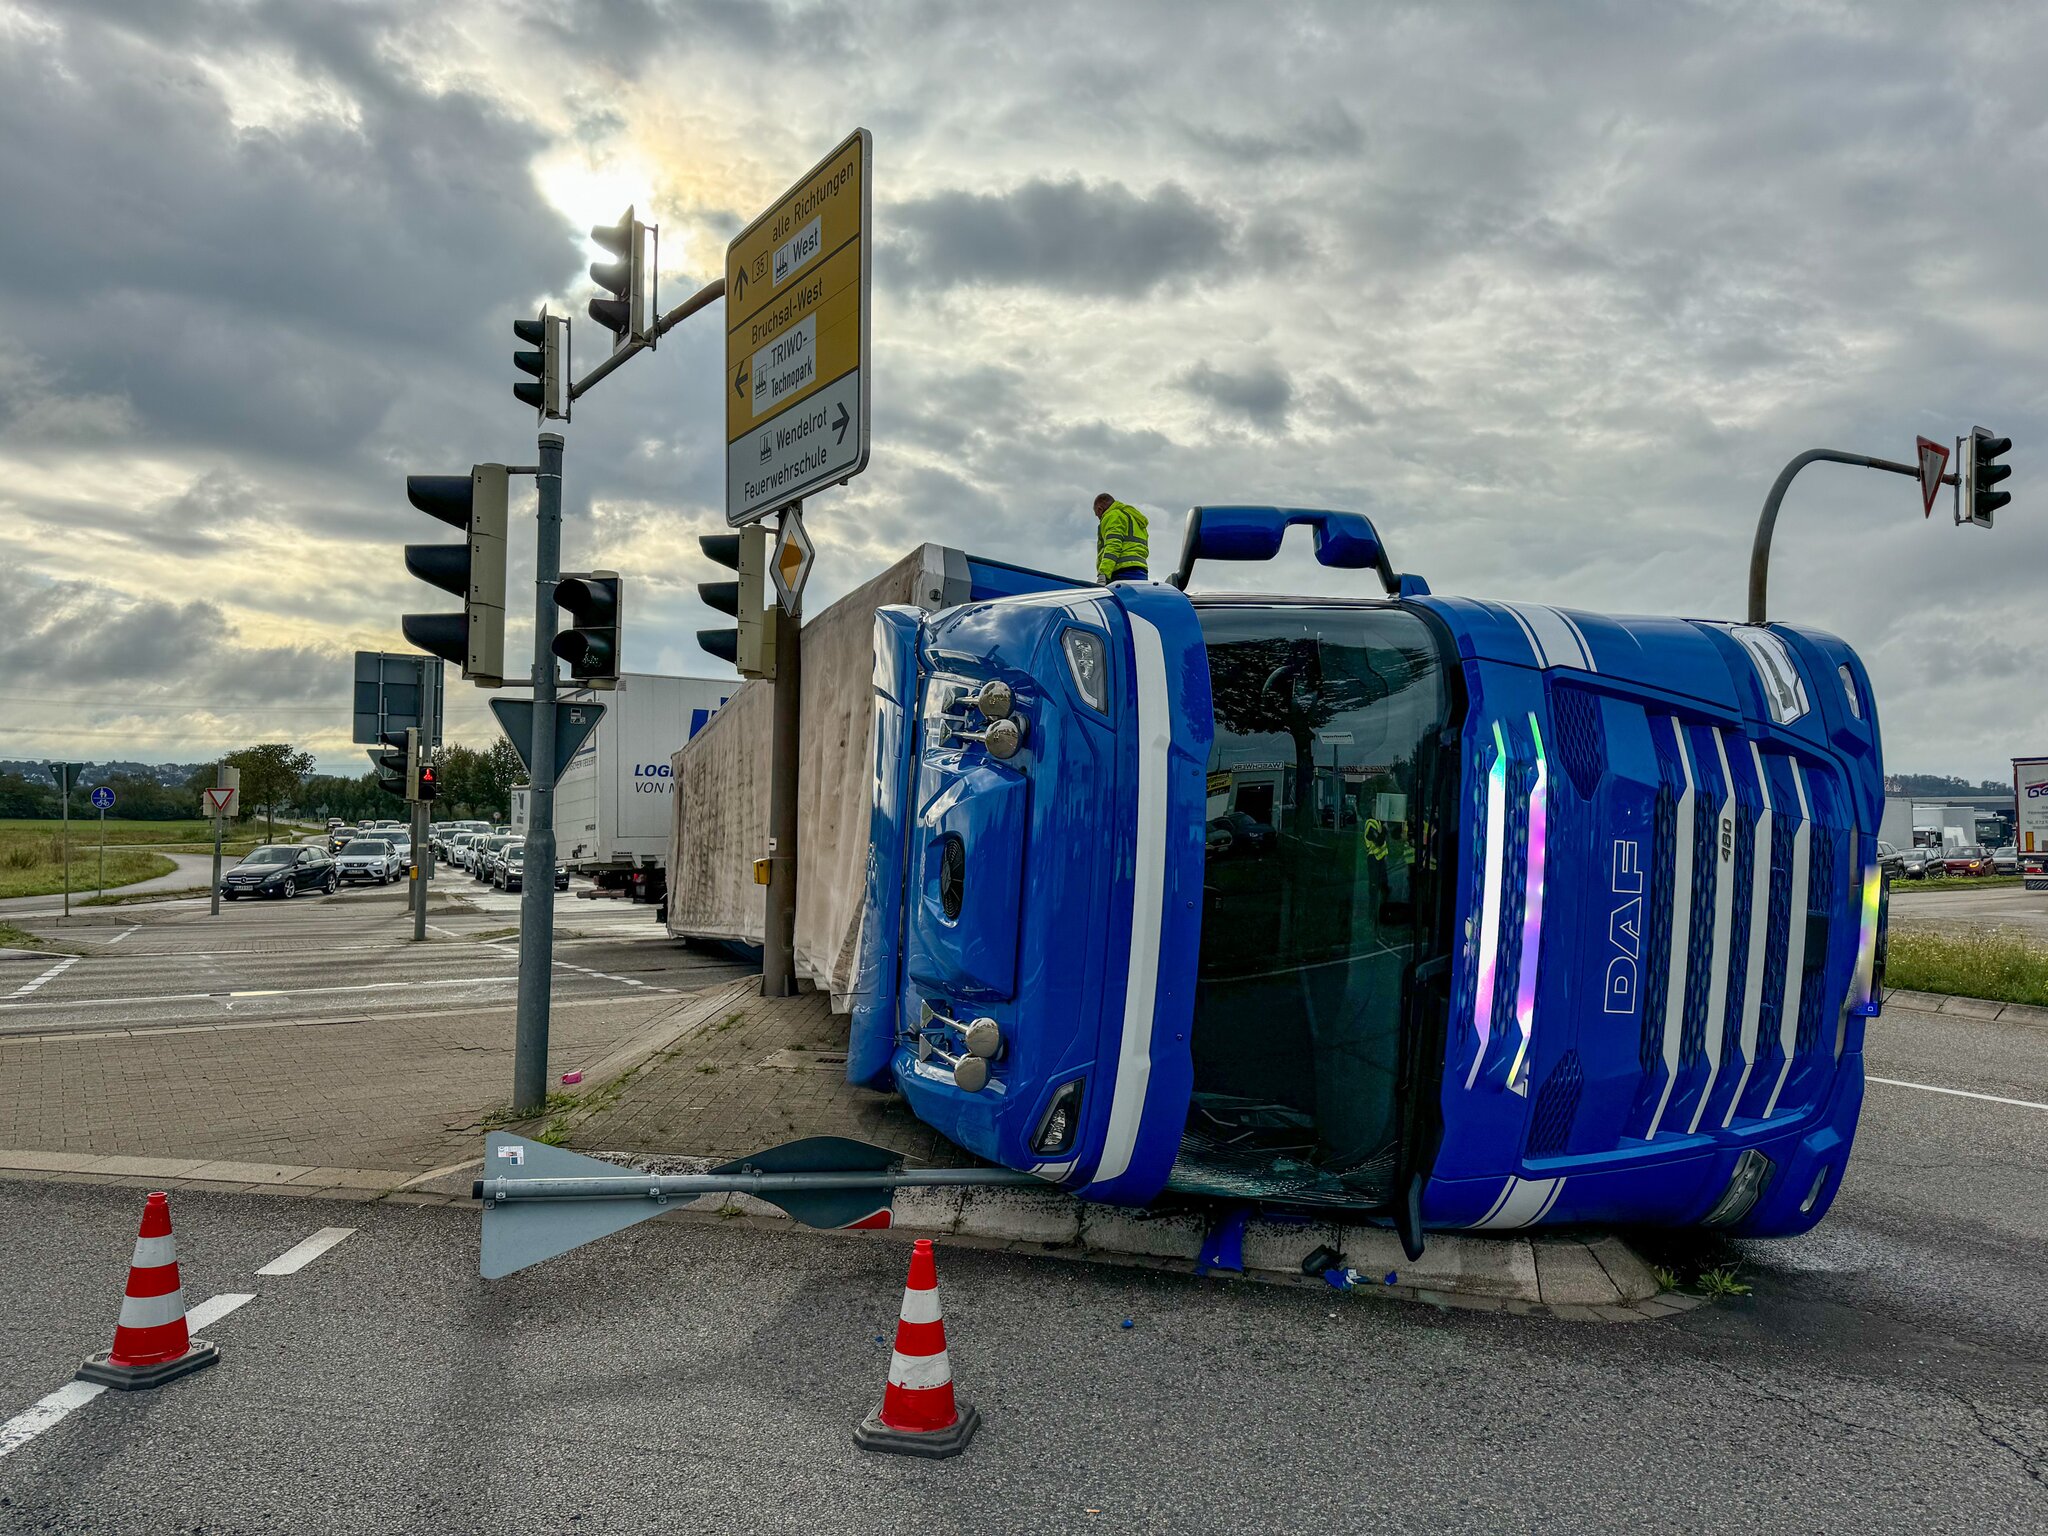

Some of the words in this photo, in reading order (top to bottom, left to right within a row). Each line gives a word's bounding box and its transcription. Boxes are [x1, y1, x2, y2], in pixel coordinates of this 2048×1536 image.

[772, 215, 790, 242] alle
[794, 161, 853, 224] Richtungen
[792, 227, 819, 262] West
[756, 258, 765, 277] 35
[751, 277, 823, 345] Bruchsal-West
[771, 330, 808, 368] TRIWO-
[771, 356, 813, 398] Technopark
[776, 406, 828, 451] Wendelrot
[744, 446, 827, 502] Feuerwehrschule
[635, 782, 665, 793] VON
[1721, 818, 1732, 863] 480
[1604, 840, 1643, 1014] DAF
